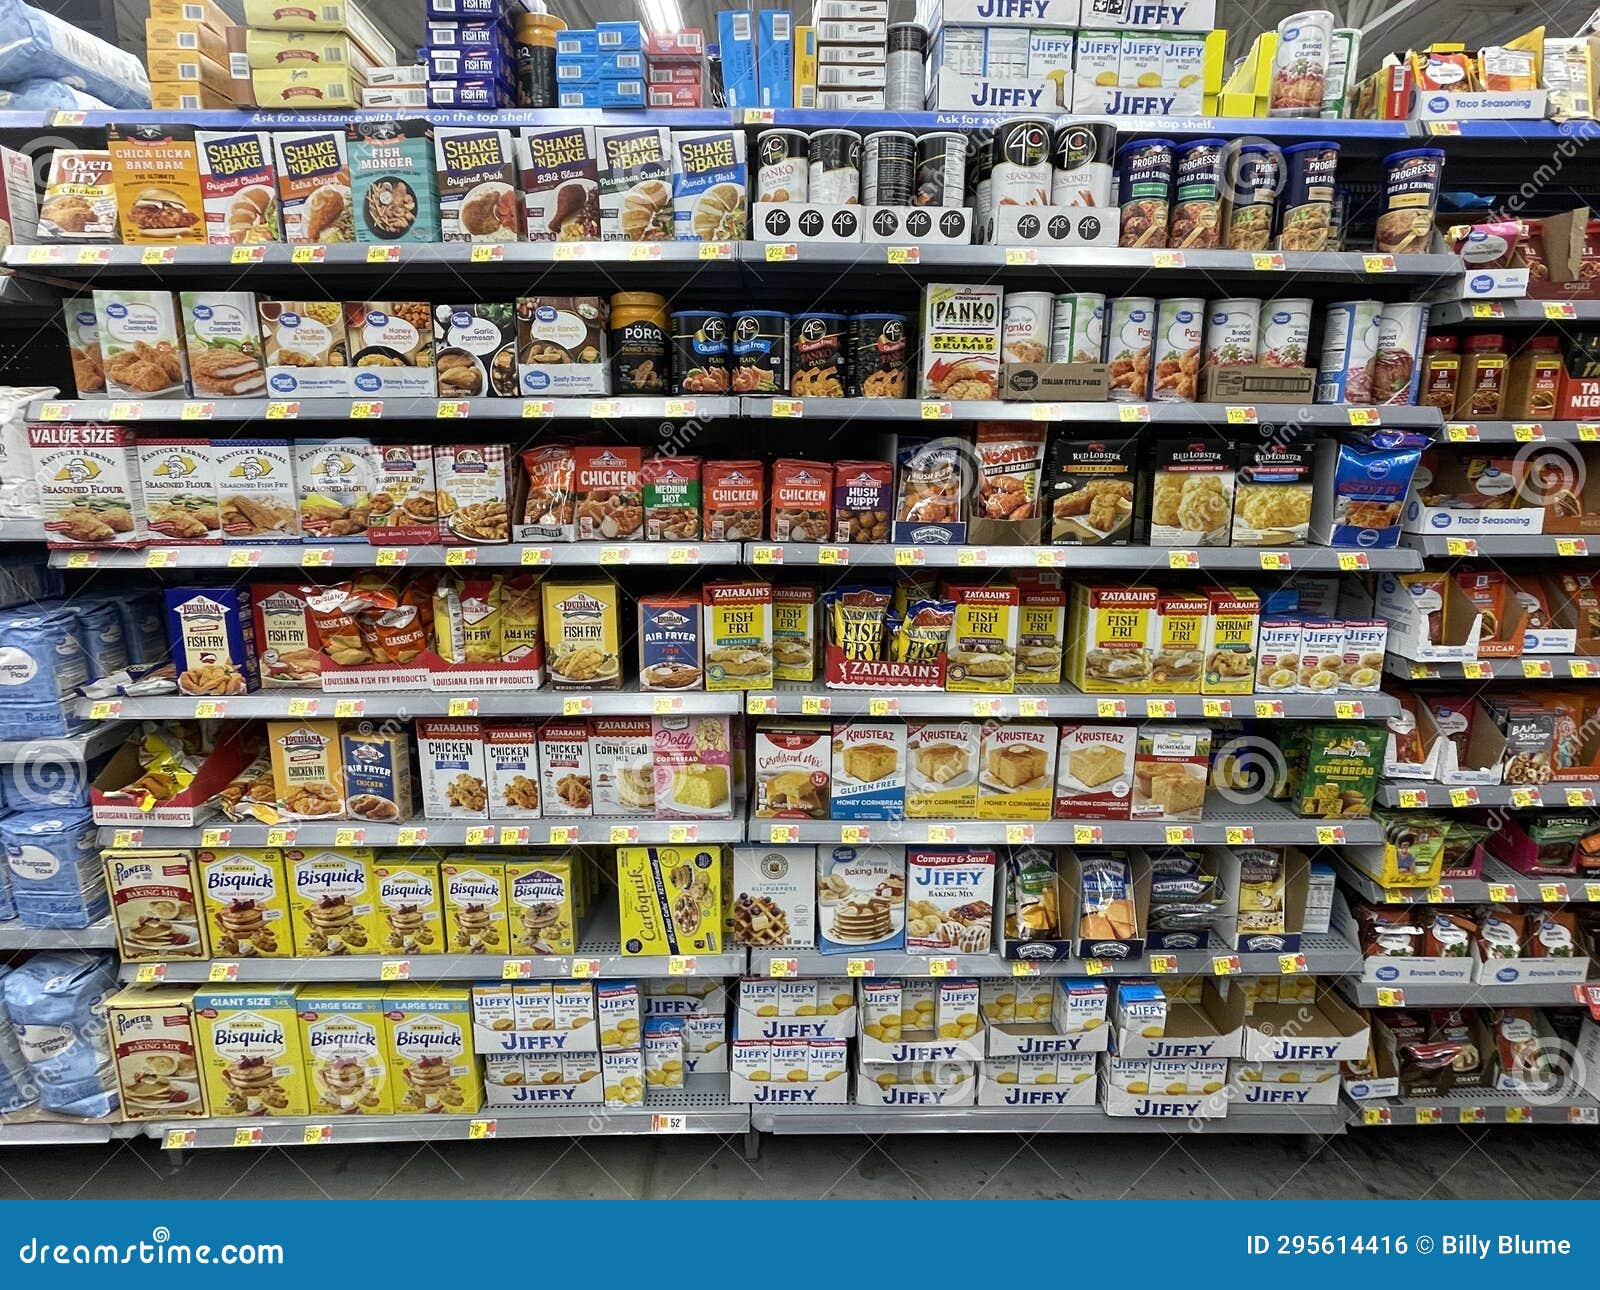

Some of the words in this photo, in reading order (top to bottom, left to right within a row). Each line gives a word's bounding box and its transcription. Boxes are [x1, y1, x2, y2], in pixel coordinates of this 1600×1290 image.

[462, 31, 477, 41] FISH
[478, 30, 491, 41] FRY
[1455, 98, 1478, 110] Taco
[1480, 98, 1531, 110] Seasoning
[252, 113, 274, 123] Ask
[277, 112, 296, 122] for
[298, 112, 362, 122] assistance
[365, 112, 392, 122] with
[434, 113, 448, 121] on
[453, 112, 473, 121] the
[477, 113, 498, 124] top
[501, 112, 534, 122] shelf.
[116, 150, 152, 159] CHICA
[155, 150, 191, 159] LICKA
[208, 141, 258, 165] SHAKE
[372, 148, 400, 157] FISH
[445, 138, 497, 161] SHAKE
[62, 157, 112, 171] Oven
[126, 161, 153, 170] BAM
[157, 161, 184, 170] BAM
[223, 156, 262, 175] BAKE
[361, 158, 413, 169] MONGER
[461, 151, 500, 171] BAKE
[70, 170, 101, 186] fry
[537, 172, 559, 184] BBQ
[561, 170, 584, 179] Glaze
[600, 174, 639, 187] Parmesan
[640, 168, 670, 180] Crusted
[759, 166, 793, 181] PANKO
[1391, 164, 1436, 182] PROGRESSO
[447, 176, 481, 187] Original
[483, 172, 503, 182] Pork
[61, 187, 104, 195] Chicken
[1388, 184, 1409, 193] BREAD
[1411, 182, 1434, 191] CRUMBS
[936, 301, 995, 323] PANKO
[934, 336, 994, 344] BREAD
[933, 343, 993, 351] CRUMBS
[1571, 395, 1600, 407] NIG
[31, 429, 77, 444] VALUE
[82, 429, 115, 443] SIZE
[40, 449, 80, 466] KENTUCKY
[83, 448, 116, 466] KERNEL
[1073, 452, 1087, 460] RED
[1089, 451, 1121, 460] LOBSTER
[580, 470, 637, 486] CHICKEN
[42, 485, 88, 494] SEASONED
[91, 485, 124, 494] FLOUR
[655, 485, 687, 494] MEDIUM
[780, 489, 826, 500] CHICKEN
[849, 487, 877, 497] HUSH
[662, 494, 680, 503] HOT
[847, 497, 879, 507] PUPPY
[1457, 515, 1478, 525] Taco
[1481, 515, 1530, 527] Seasoning
[714, 588, 769, 598] ZATARAIN'S
[183, 605, 221, 614] LOUISIANA
[563, 602, 600, 610] LOUISIANA
[1217, 601, 1260, 611] ZATARAIN'S
[723, 612, 753, 623] FISH
[967, 611, 999, 622] FISH
[728, 623, 748, 634] FRI
[972, 623, 993, 633] FRI
[1216, 620, 1253, 631] SHRIMP
[564, 626, 581, 638] FISH
[583, 626, 602, 638] FRY
[646, 633, 662, 642] AIR
[665, 632, 696, 641] FRYER
[845, 622, 880, 642] FISH
[1225, 631, 1242, 641] FRI
[187, 636, 207, 648] FISH
[209, 636, 224, 648] FRY
[850, 661, 940, 678] ZATARAIN'S
[433, 677, 467, 686] LOUISIANA
[469, 676, 483, 686] FISH
[485, 676, 498, 685] FRY
[499, 676, 533, 685] PRODUCTS
[427, 724, 479, 732] ZATARAIN'S
[1512, 724, 1536, 734] BAJA
[847, 731, 895, 742] KRUSTEAZ
[1075, 732, 1123, 743] KRUSTEAZ
[1519, 732, 1549, 740] SHRIMP
[429, 743, 472, 754] CHICKEN
[655, 734, 694, 752] Dolly
[596, 744, 647, 755] CORNBREAD
[289, 767, 310, 776] CHICKEN
[312, 766, 324, 775] FRY
[348, 765, 362, 773] AIR
[365, 766, 390, 776] FRYER
[1315, 767, 1338, 775] CORN
[1342, 767, 1373, 775] BREAD
[840, 783, 873, 795] GLUTEN
[875, 779, 897, 790] FREE
[837, 799, 858, 807] HONEY
[860, 799, 903, 807] CORNBREAD
[1060, 799, 1089, 807] SOUTHERN
[917, 855, 955, 864] Compare
[957, 855, 965, 863] &
[967, 855, 988, 863] Save!
[116, 863, 152, 886] PIONEER
[845, 868, 870, 876] Baking
[872, 867, 888, 875] Mix
[208, 873, 273, 889] Bisquick
[127, 890, 160, 899] BAKING
[162, 889, 180, 898] MIX
[382, 884, 432, 897] Bisquick
[514, 885, 564, 897] Bisquick
[1439, 970, 1464, 978] Gravy
[211, 998, 244, 1006] GIANT
[247, 998, 271, 1006] SIZE
[343, 1002, 363, 1010] SIZE
[215, 1029, 284, 1047] Bisquick
[311, 1031, 375, 1047] Bisquick
